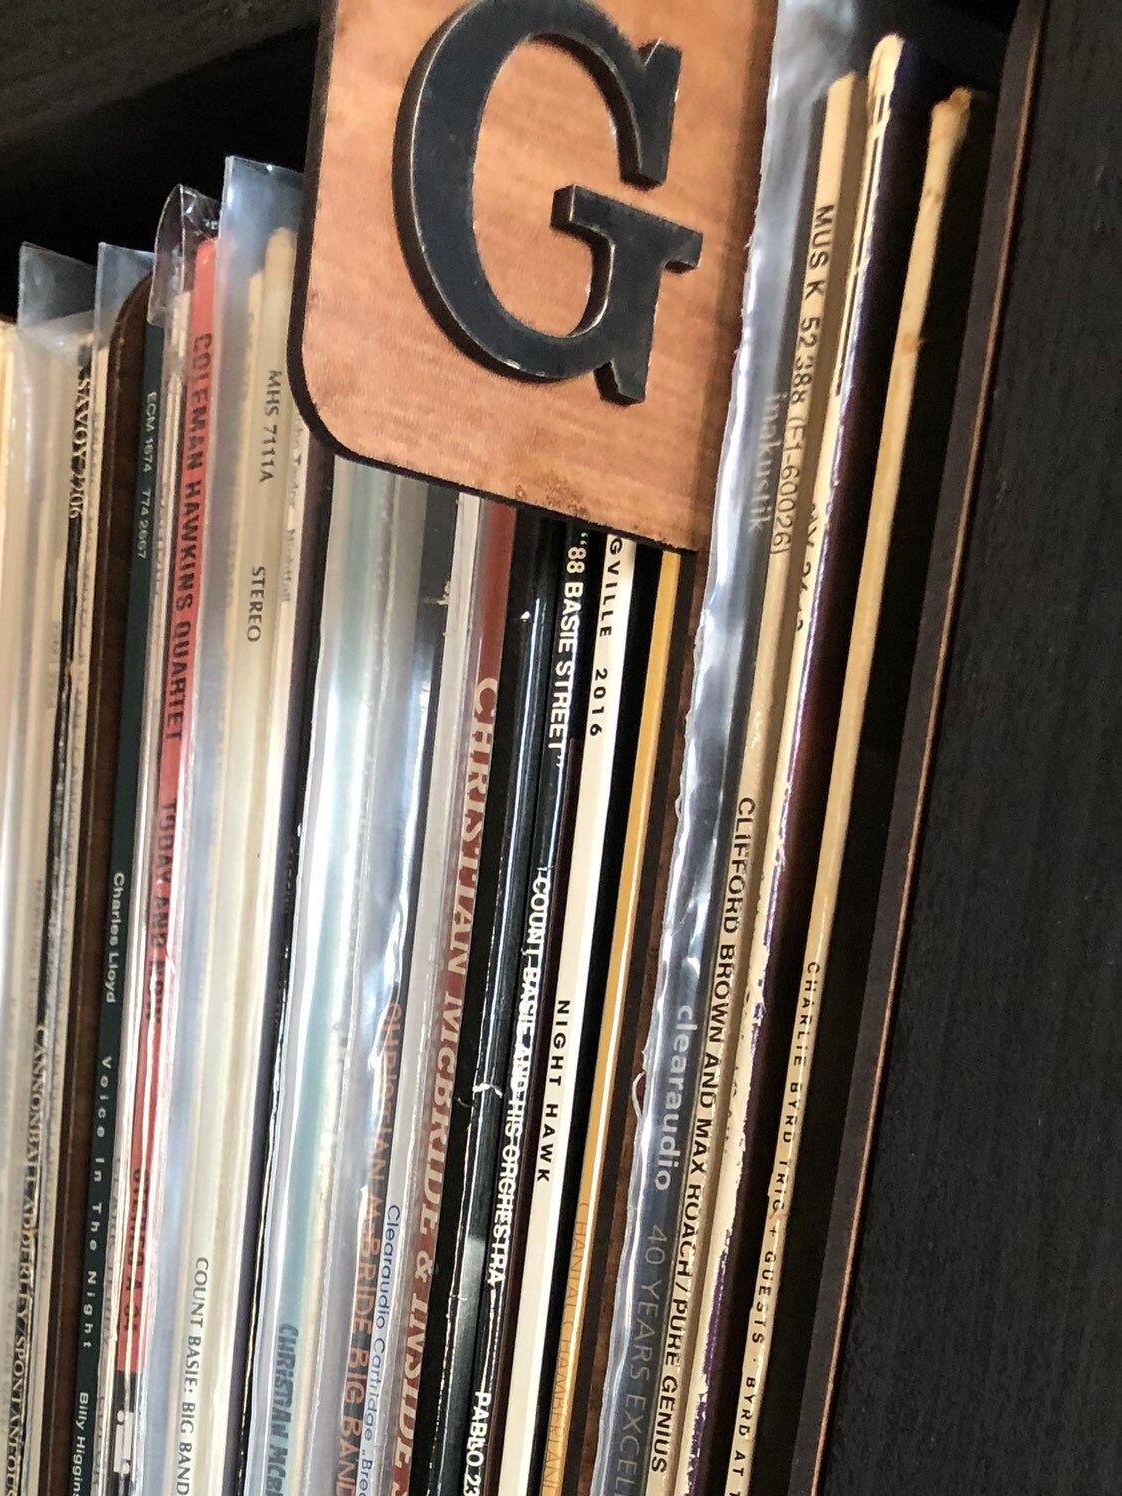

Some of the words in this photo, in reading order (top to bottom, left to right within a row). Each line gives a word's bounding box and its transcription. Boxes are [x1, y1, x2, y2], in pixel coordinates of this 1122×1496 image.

[392, 0, 702, 406] G
[807, 202, 834, 272] MUS
[803, 279, 823, 301] K
[797, 315, 818, 346] 52
[69, 377, 91, 467] SAVOY
[143, 391, 157, 432] ECM
[183, 332, 212, 471] COLEMAN
[263, 370, 282, 417] MHS
[257, 423, 277, 484] 7111A
[744, 391, 787, 536] inakustik
[138, 488, 150, 518] 774
[174, 478, 201, 613] HAWKINS
[245, 564, 266, 642] STEREO
[557, 581, 583, 654] BASIE
[165, 619, 191, 740] QUARTET
[588, 667, 608, 737] 2016
[445, 675, 499, 975] CHRISTIAN
[720, 796, 756, 935] CLIFFORD
[107, 871, 125, 946] Charles
[522, 875, 550, 956] COUNT
[102, 951, 120, 1004] Lloyd
[514, 966, 539, 1034] BASIE
[706, 943, 736, 1043] BROWN
[792, 961, 819, 1067] CHARLIE
[547, 999, 570, 1086] NIGHT
[23, 1024, 51, 1187] CANNONBALL
[95, 1055, 112, 1138] Voice
[652, 1003, 699, 1192] clearaudio
[697, 1053, 721, 1108] AND
[781, 1082, 801, 1143] BYRD
[502, 1099, 523, 1137] HIS
[536, 1102, 559, 1183] HAWK
[689, 1117, 712, 1173] MAX
[92, 1156, 105, 1183] In
[87, 1201, 102, 1252] The
[486, 1144, 518, 1286] ORCHESTRA
[643, 1223, 668, 1266] 40
[188, 1256, 209, 1328] COUNT
[374, 1203, 401, 1330] Clearaudio
[414, 1249, 435, 1281] &
[751, 1250, 776, 1344] GUESTS
[79, 1269, 98, 1348] Night
[628, 1278, 661, 1381] YEARS
[182, 1334, 201, 1394] BASIE:
[269, 1324, 299, 1439] CHRISTIAN
[343, 1344, 370, 1404] BIG
[361, 1337, 387, 1441] Cartridge
[392, 1292, 429, 1469] INSIDE
[73, 1391, 89, 1431] Billy
[178, 1401, 196, 1434] BIG
[649, 1374, 677, 1473] GENIUS
[737, 1376, 757, 1437] BYRD
[173, 1441, 192, 1496] BAND
[731, 1450, 746, 1477] AT
